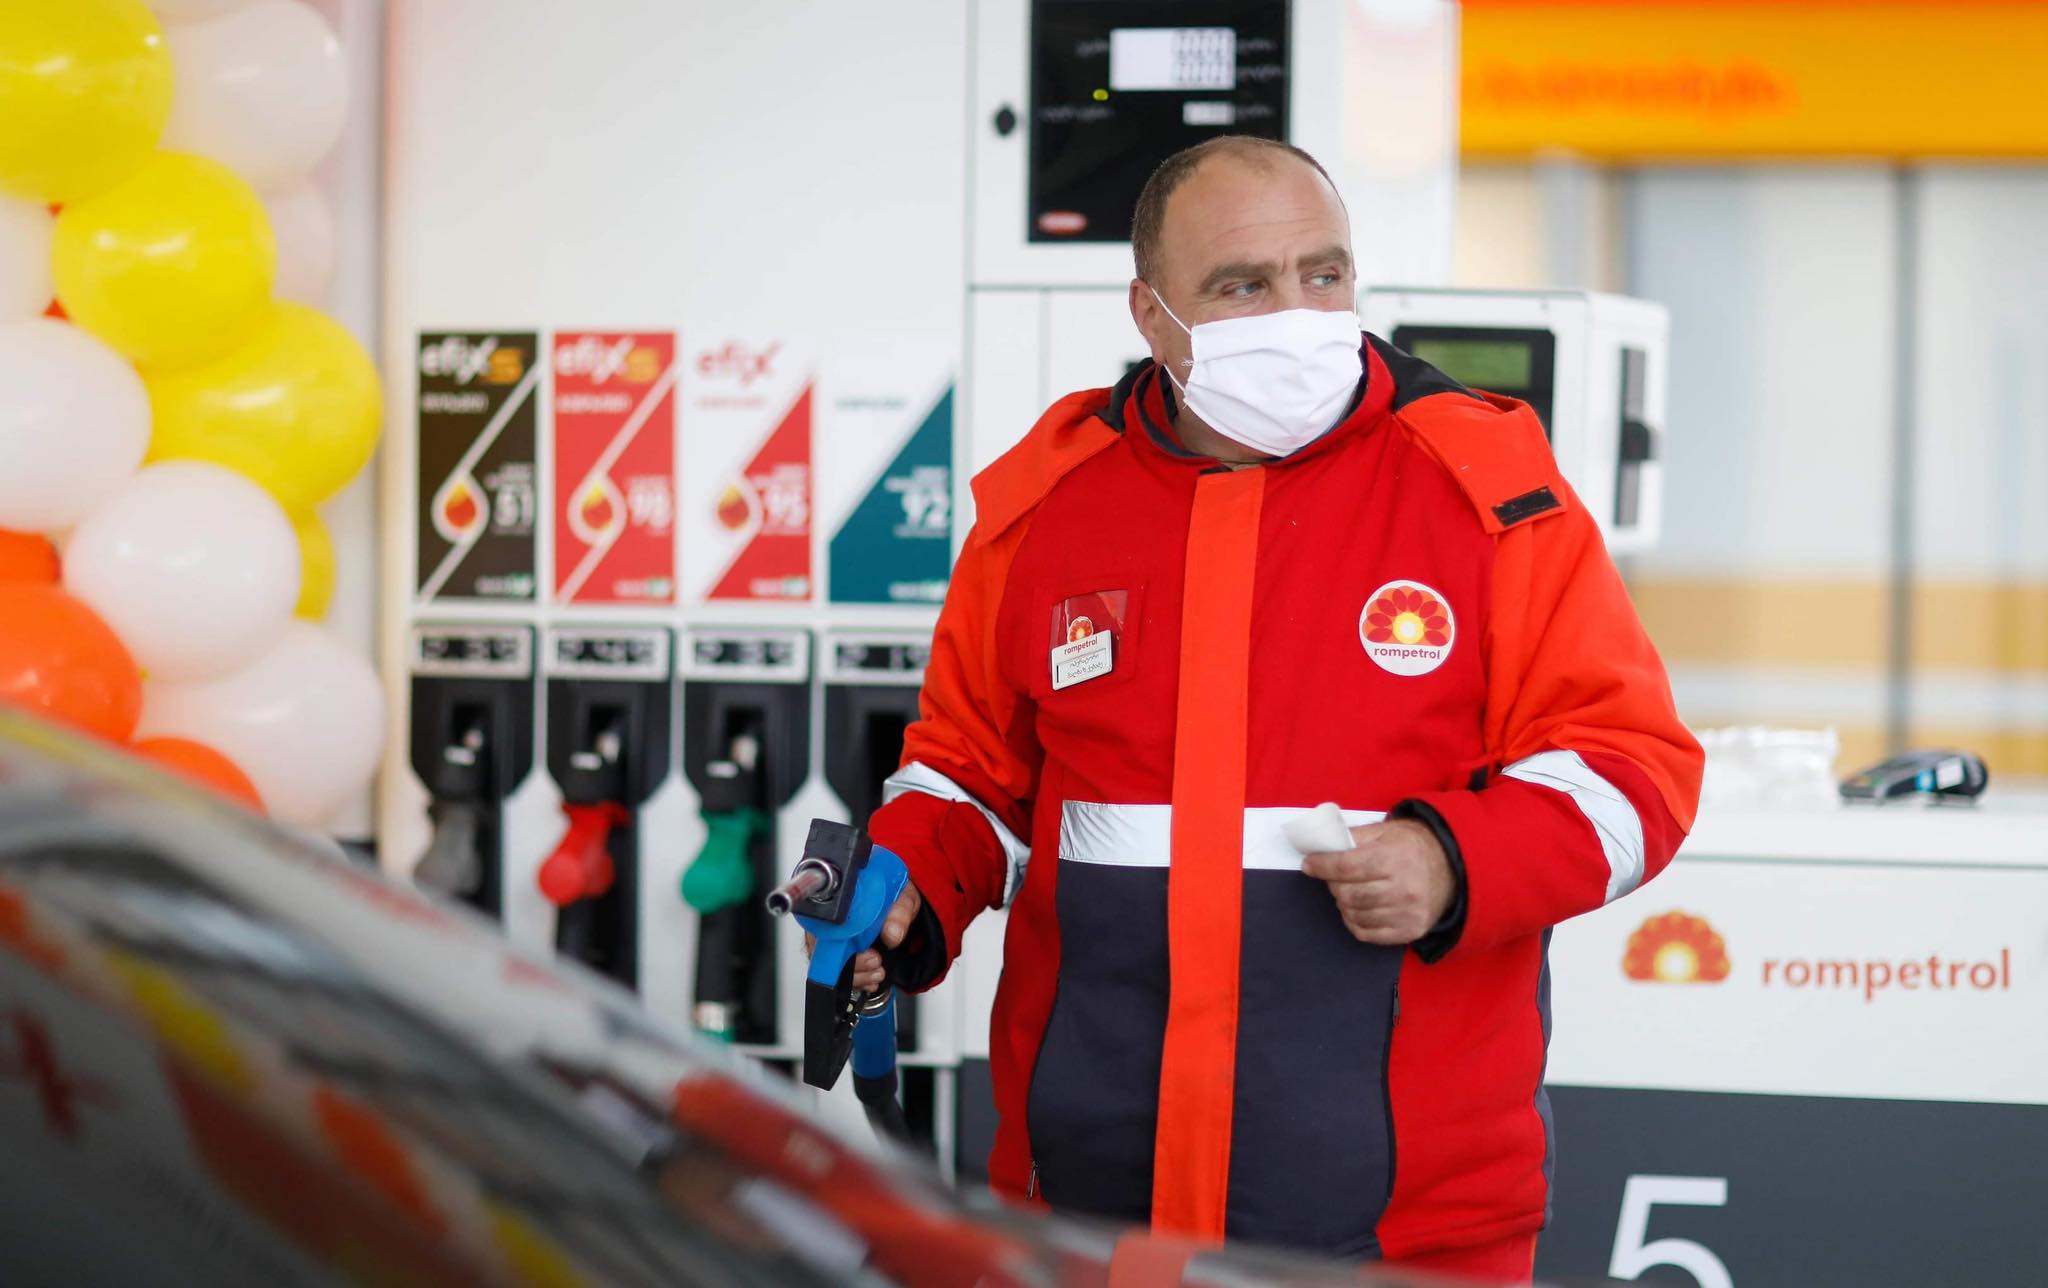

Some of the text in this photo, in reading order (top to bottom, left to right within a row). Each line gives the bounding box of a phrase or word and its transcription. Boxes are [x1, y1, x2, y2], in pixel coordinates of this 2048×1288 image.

[902, 491, 949, 527] 92
[1064, 637, 1098, 655] rompetrol
[1373, 648, 1441, 660] rompetrol
[1763, 948, 2011, 1002] rompetrol
[1608, 1174, 1736, 1288] 5
